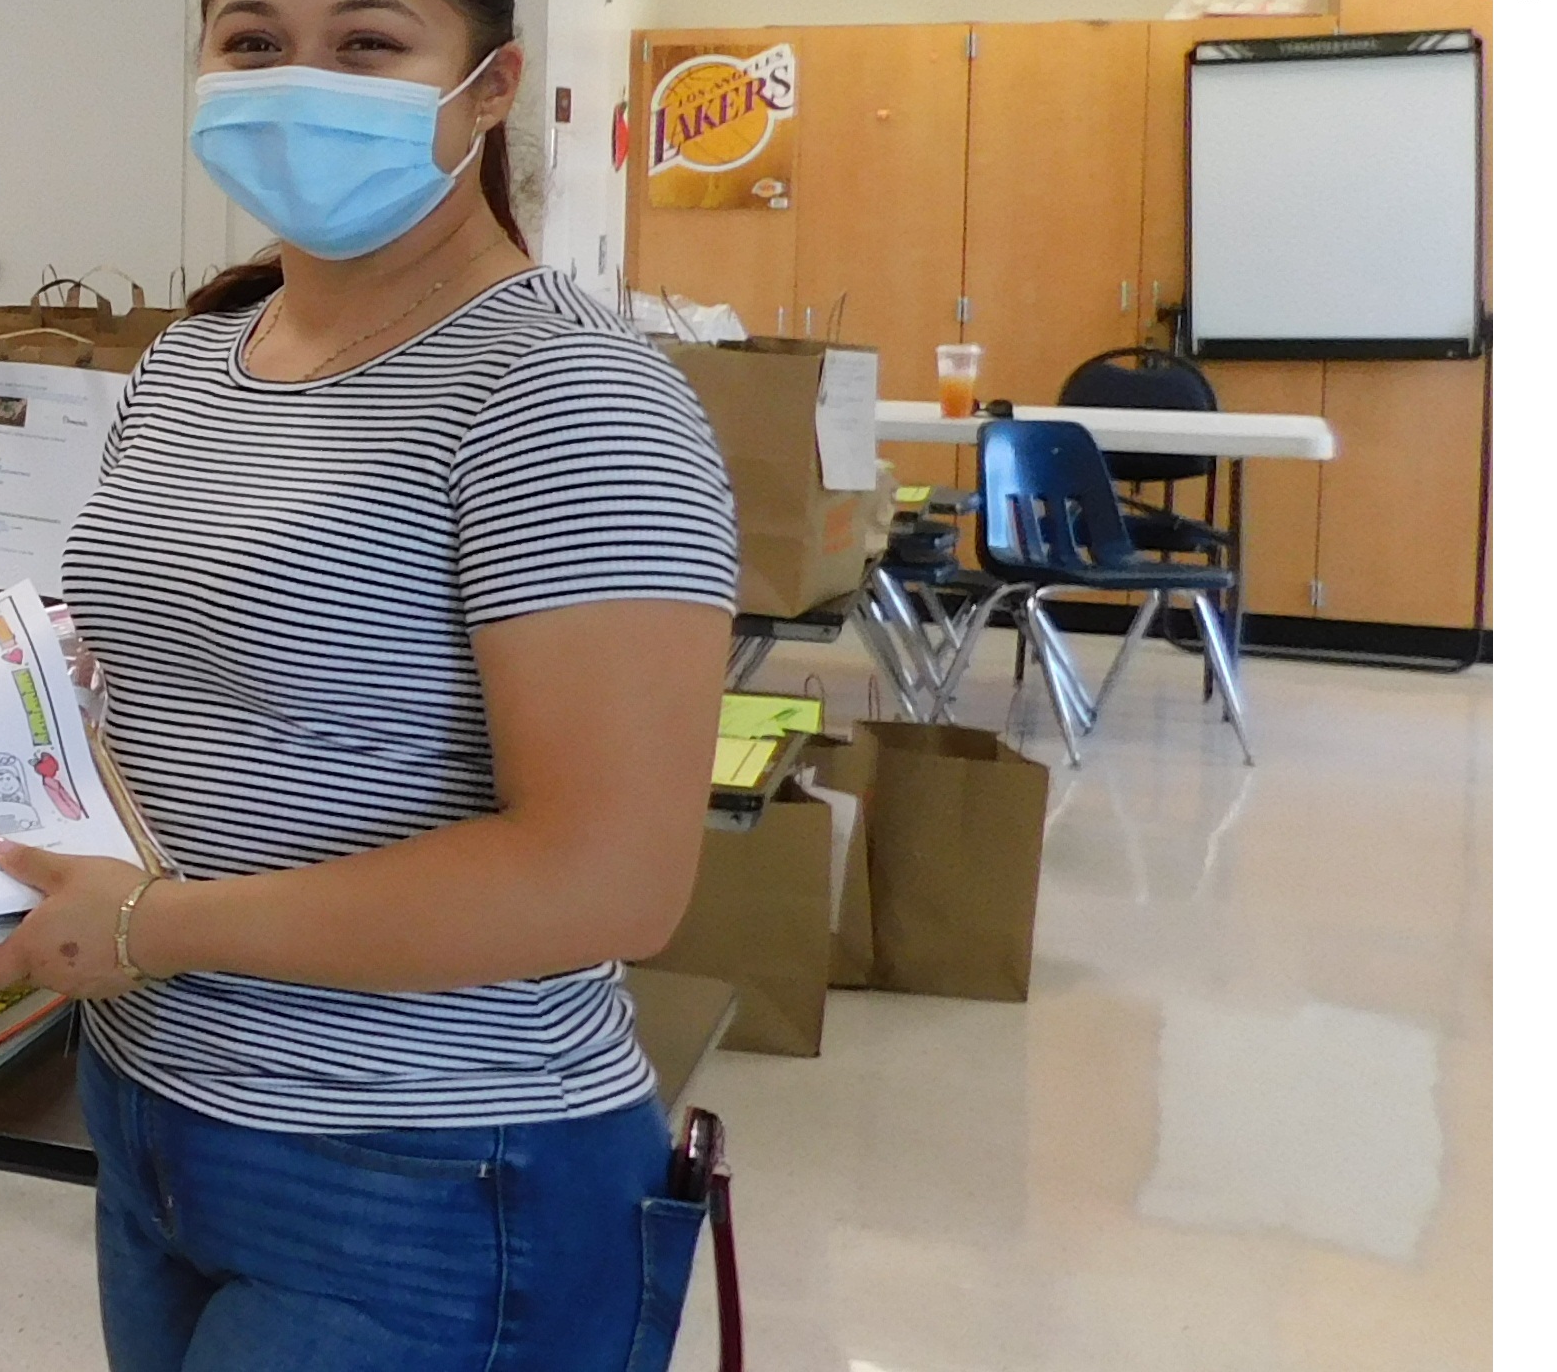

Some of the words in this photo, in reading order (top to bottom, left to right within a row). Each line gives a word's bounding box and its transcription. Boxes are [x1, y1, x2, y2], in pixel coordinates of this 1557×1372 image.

[654, 66, 793, 168] LAKERS
[679, 89, 705, 107] LOS
[710, 51, 783, 91] ANGELES
